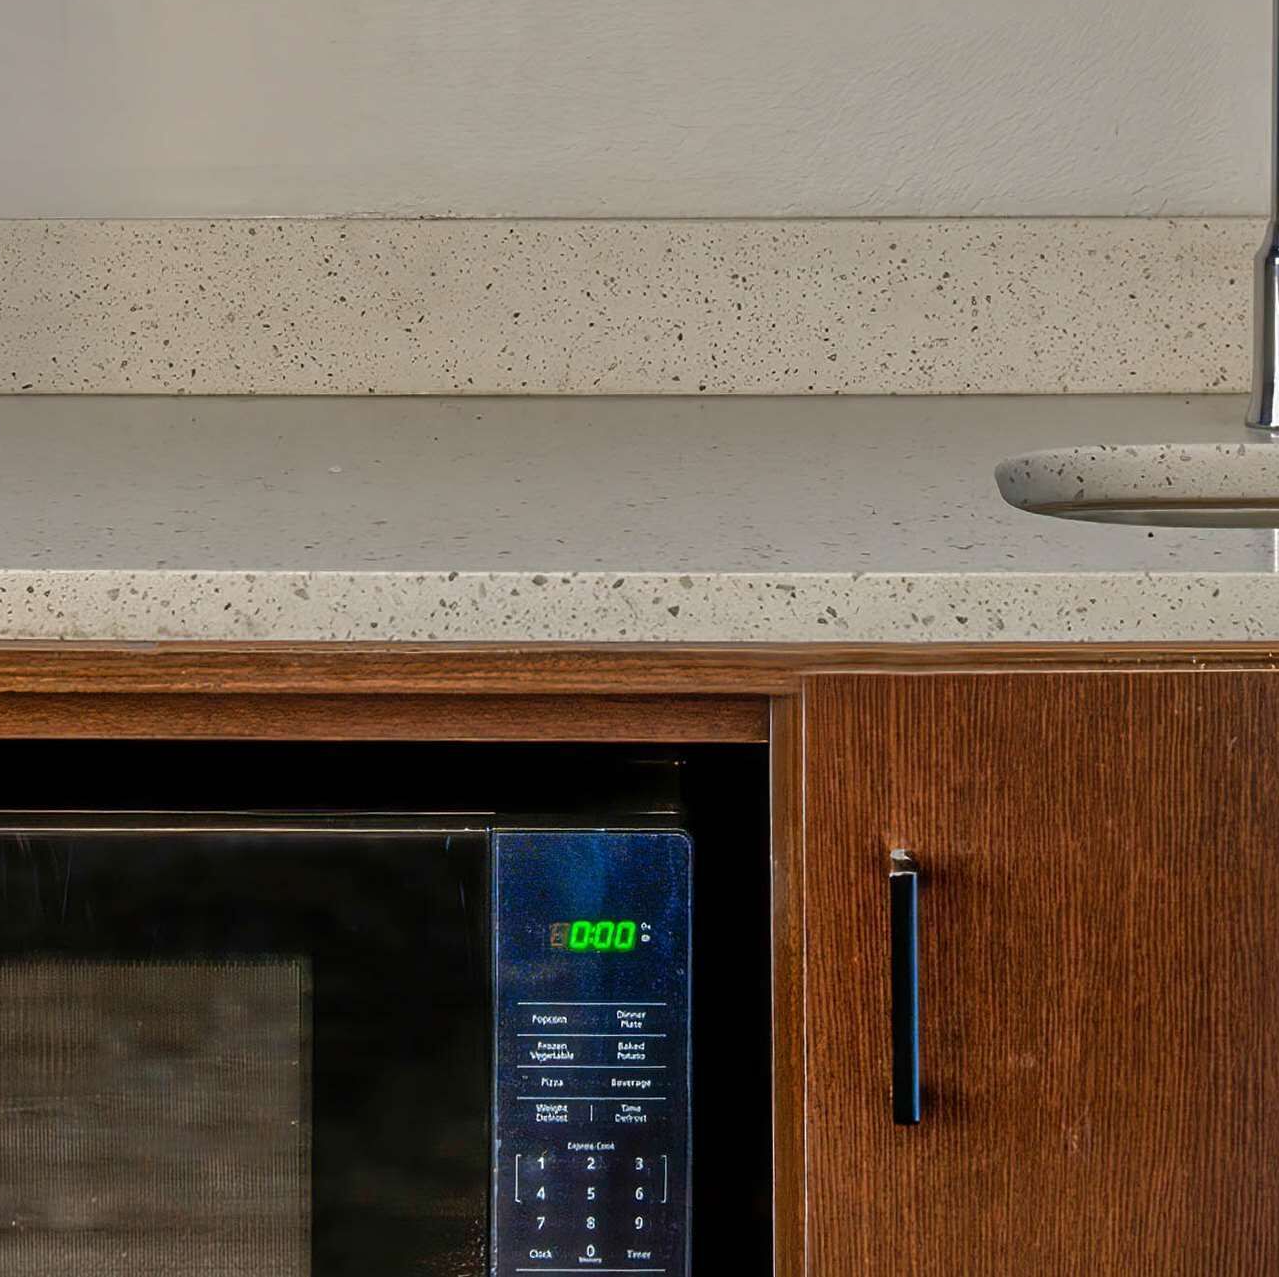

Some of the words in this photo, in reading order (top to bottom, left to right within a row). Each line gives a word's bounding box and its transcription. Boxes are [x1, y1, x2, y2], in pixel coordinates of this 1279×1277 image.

[531, 1014, 568, 1025] Popcorn
[616, 1010, 646, 1019] Dinner
[620, 1020, 643, 1029] Plate
[537, 1041, 568, 1050] Frozen
[617, 1041, 646, 1051] Baked
[616, 1052, 646, 1060] Potato
[540, 1077, 564, 1087] Pizza
[611, 1078, 652, 1089] Beverage
[535, 1104, 569, 1115] Weight
[621, 1104, 642, 1113] Time
[535, 1113, 569, 1123] Defrost
[614, 1113, 648, 1123] Defrost
[537, 1156, 545, 1170] 1
[586, 1157, 596, 1170] 2
[635, 1157, 644, 1170] 3
[536, 1186, 546, 1200] 4
[587, 1187, 596, 1200] 5
[635, 1187, 644, 1200] 6
[536, 1216, 546, 1230] 7
[586, 1216, 596, 1230] 8
[635, 1216, 644, 1230] 9
[529, 1249, 553, 1259] Clock
[586, 1244, 596, 1257] 0
[627, 1249, 652, 1259] Timer
